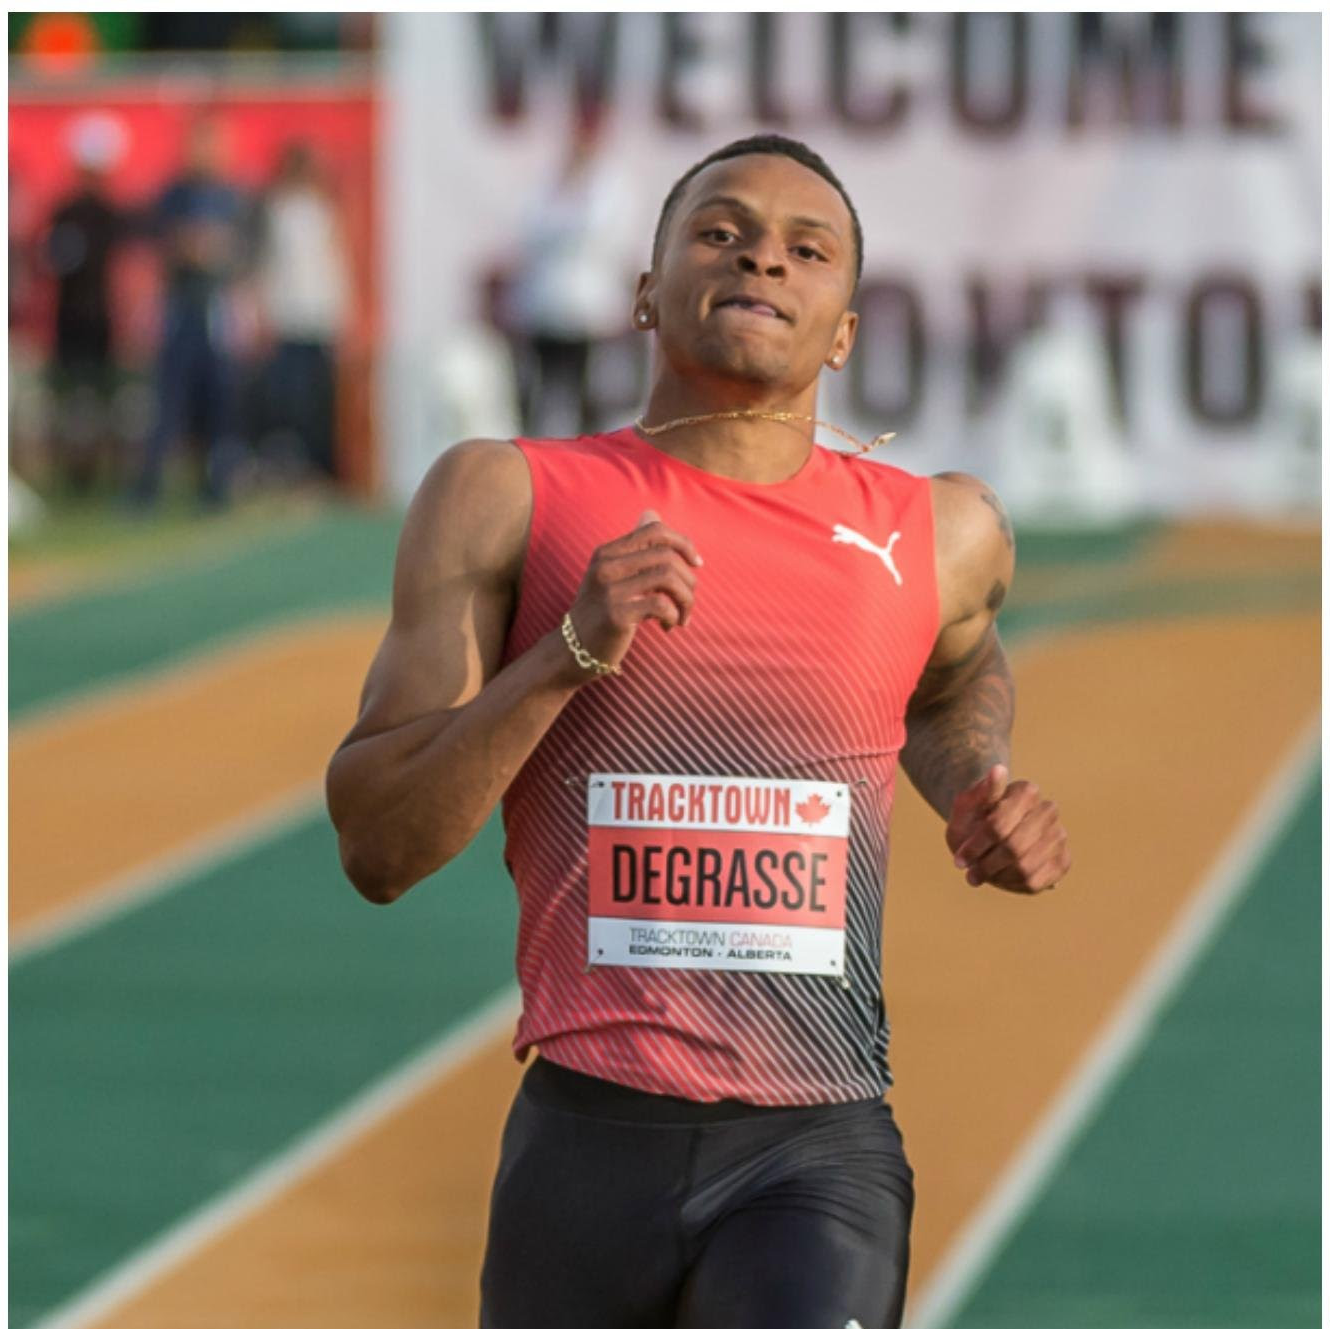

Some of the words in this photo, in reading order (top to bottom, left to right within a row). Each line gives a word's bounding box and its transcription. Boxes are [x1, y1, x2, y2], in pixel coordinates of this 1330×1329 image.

[610, 780, 791, 827] TRACKTOWN
[611, 843, 829, 914] DEGRASSE
[628, 945, 713, 959] EDMONTON
[727, 950, 793, 963] ALBERTA
[629, 928, 725, 947] TRACKTOWN
[729, 930, 793, 950] CANADA
